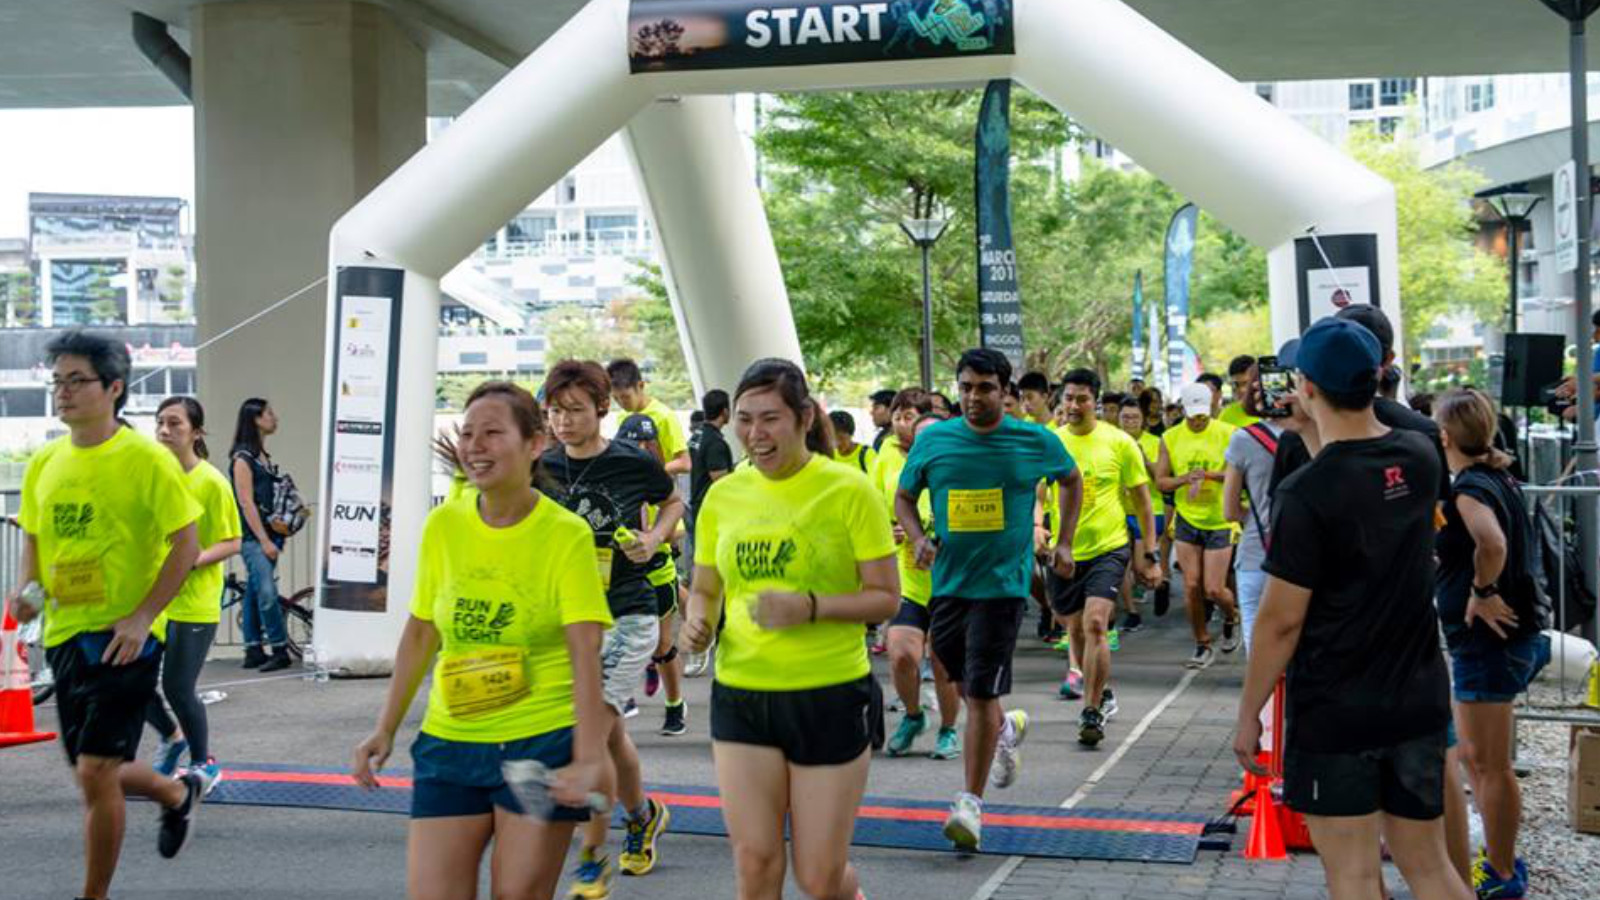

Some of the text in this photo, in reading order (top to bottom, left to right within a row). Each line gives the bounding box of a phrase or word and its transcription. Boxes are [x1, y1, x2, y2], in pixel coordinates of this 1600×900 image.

[745, 3, 888, 49] START
[990, 266, 1015, 281] 201
[334, 504, 376, 521] RUN
[736, 540, 771, 552] RUN
[736, 553, 770, 567] FOR
[738, 566, 785, 581] LIGHT
[455, 598, 491, 613] RUN
[453, 612, 487, 627] FOR
[453, 628, 502, 643] LIGHT
[481, 670, 512, 682] 1424
